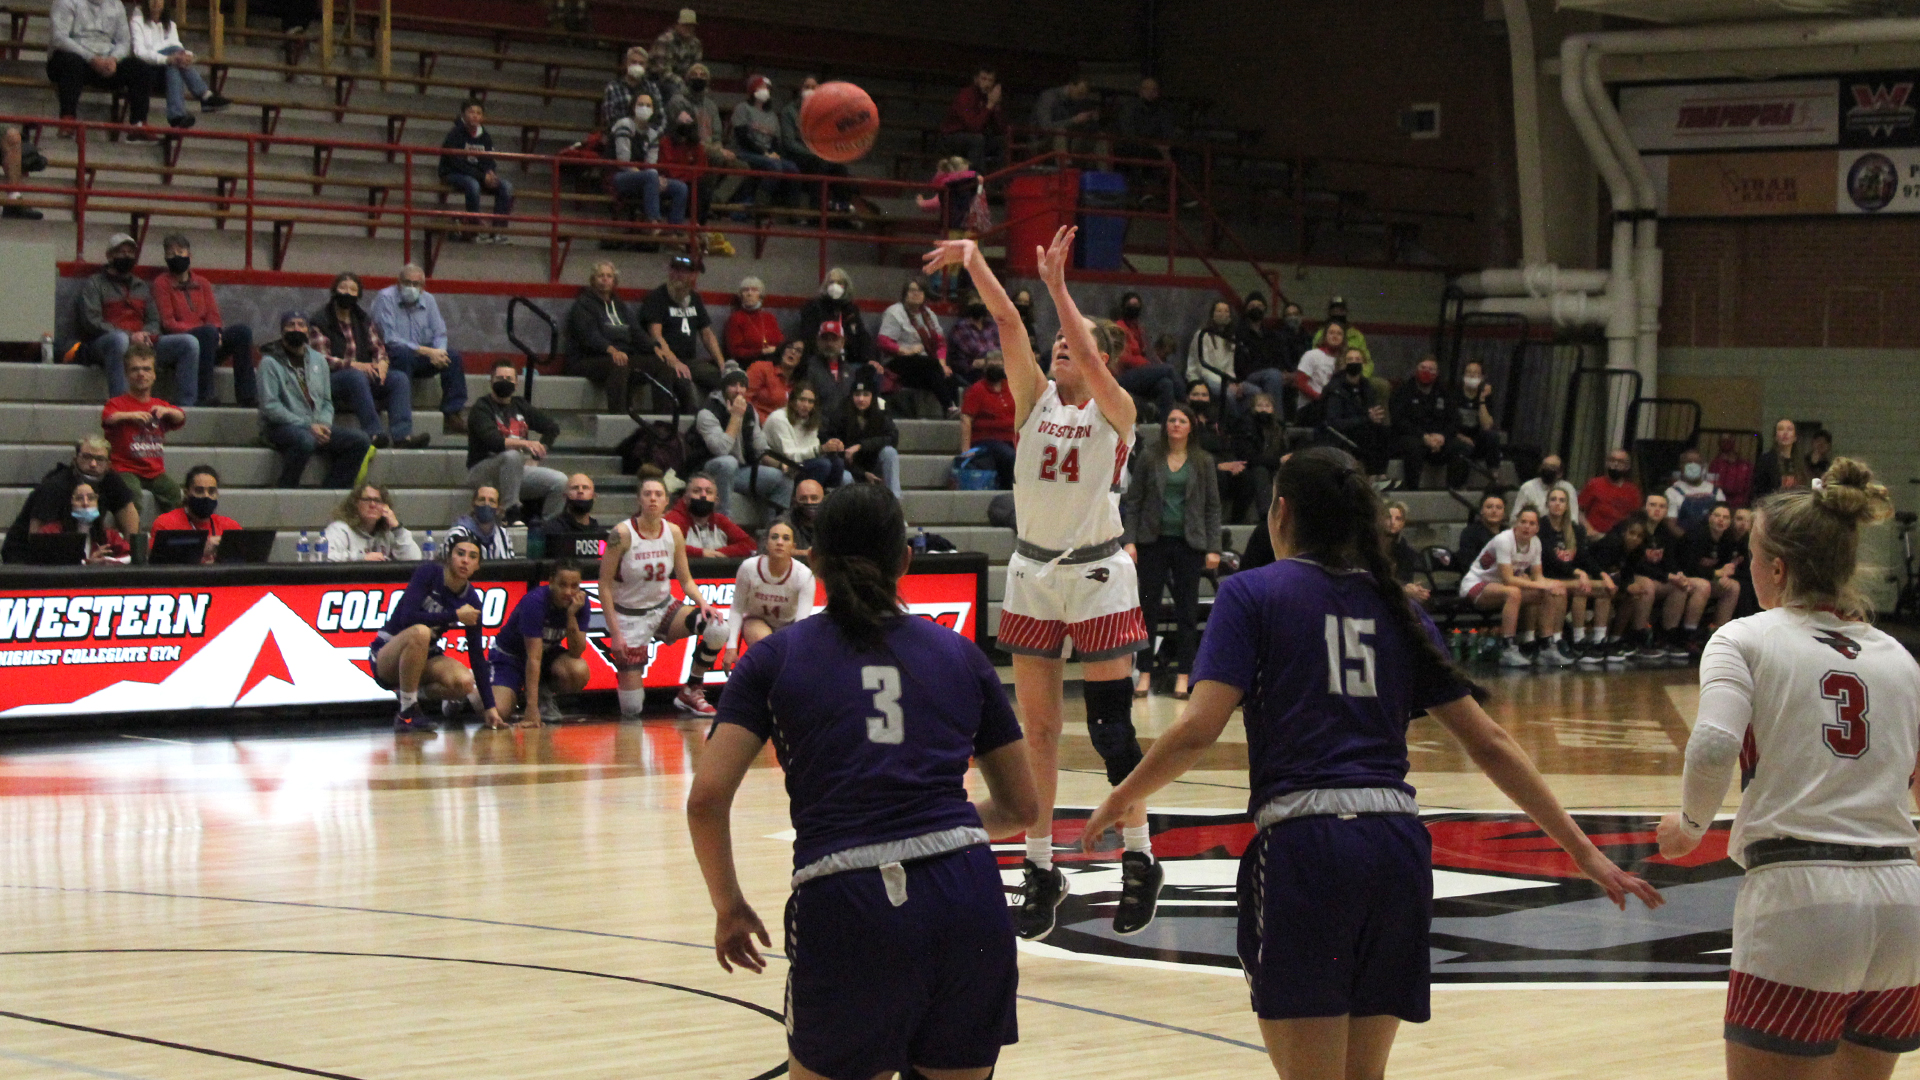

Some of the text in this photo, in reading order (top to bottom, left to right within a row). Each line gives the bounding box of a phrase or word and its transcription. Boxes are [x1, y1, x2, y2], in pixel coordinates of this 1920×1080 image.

[681, 317, 691, 336] 4
[1038, 420, 1092, 438] WESTERN
[1038, 443, 1080, 483] 24
[576, 540, 599, 555] POSS
[635, 550, 669, 561] WESTERN
[644, 563, 666, 582] 32
[683, 584, 736, 606] OME
[0, 594, 210, 641] WESTERN
[762, 604, 780, 620] 14
[0, 645, 182, 666] HIGHEST COLLEGIATE GYM
[1324, 613, 1378, 698] 15
[861, 665, 905, 745] 3
[1819, 669, 1870, 760] 3
